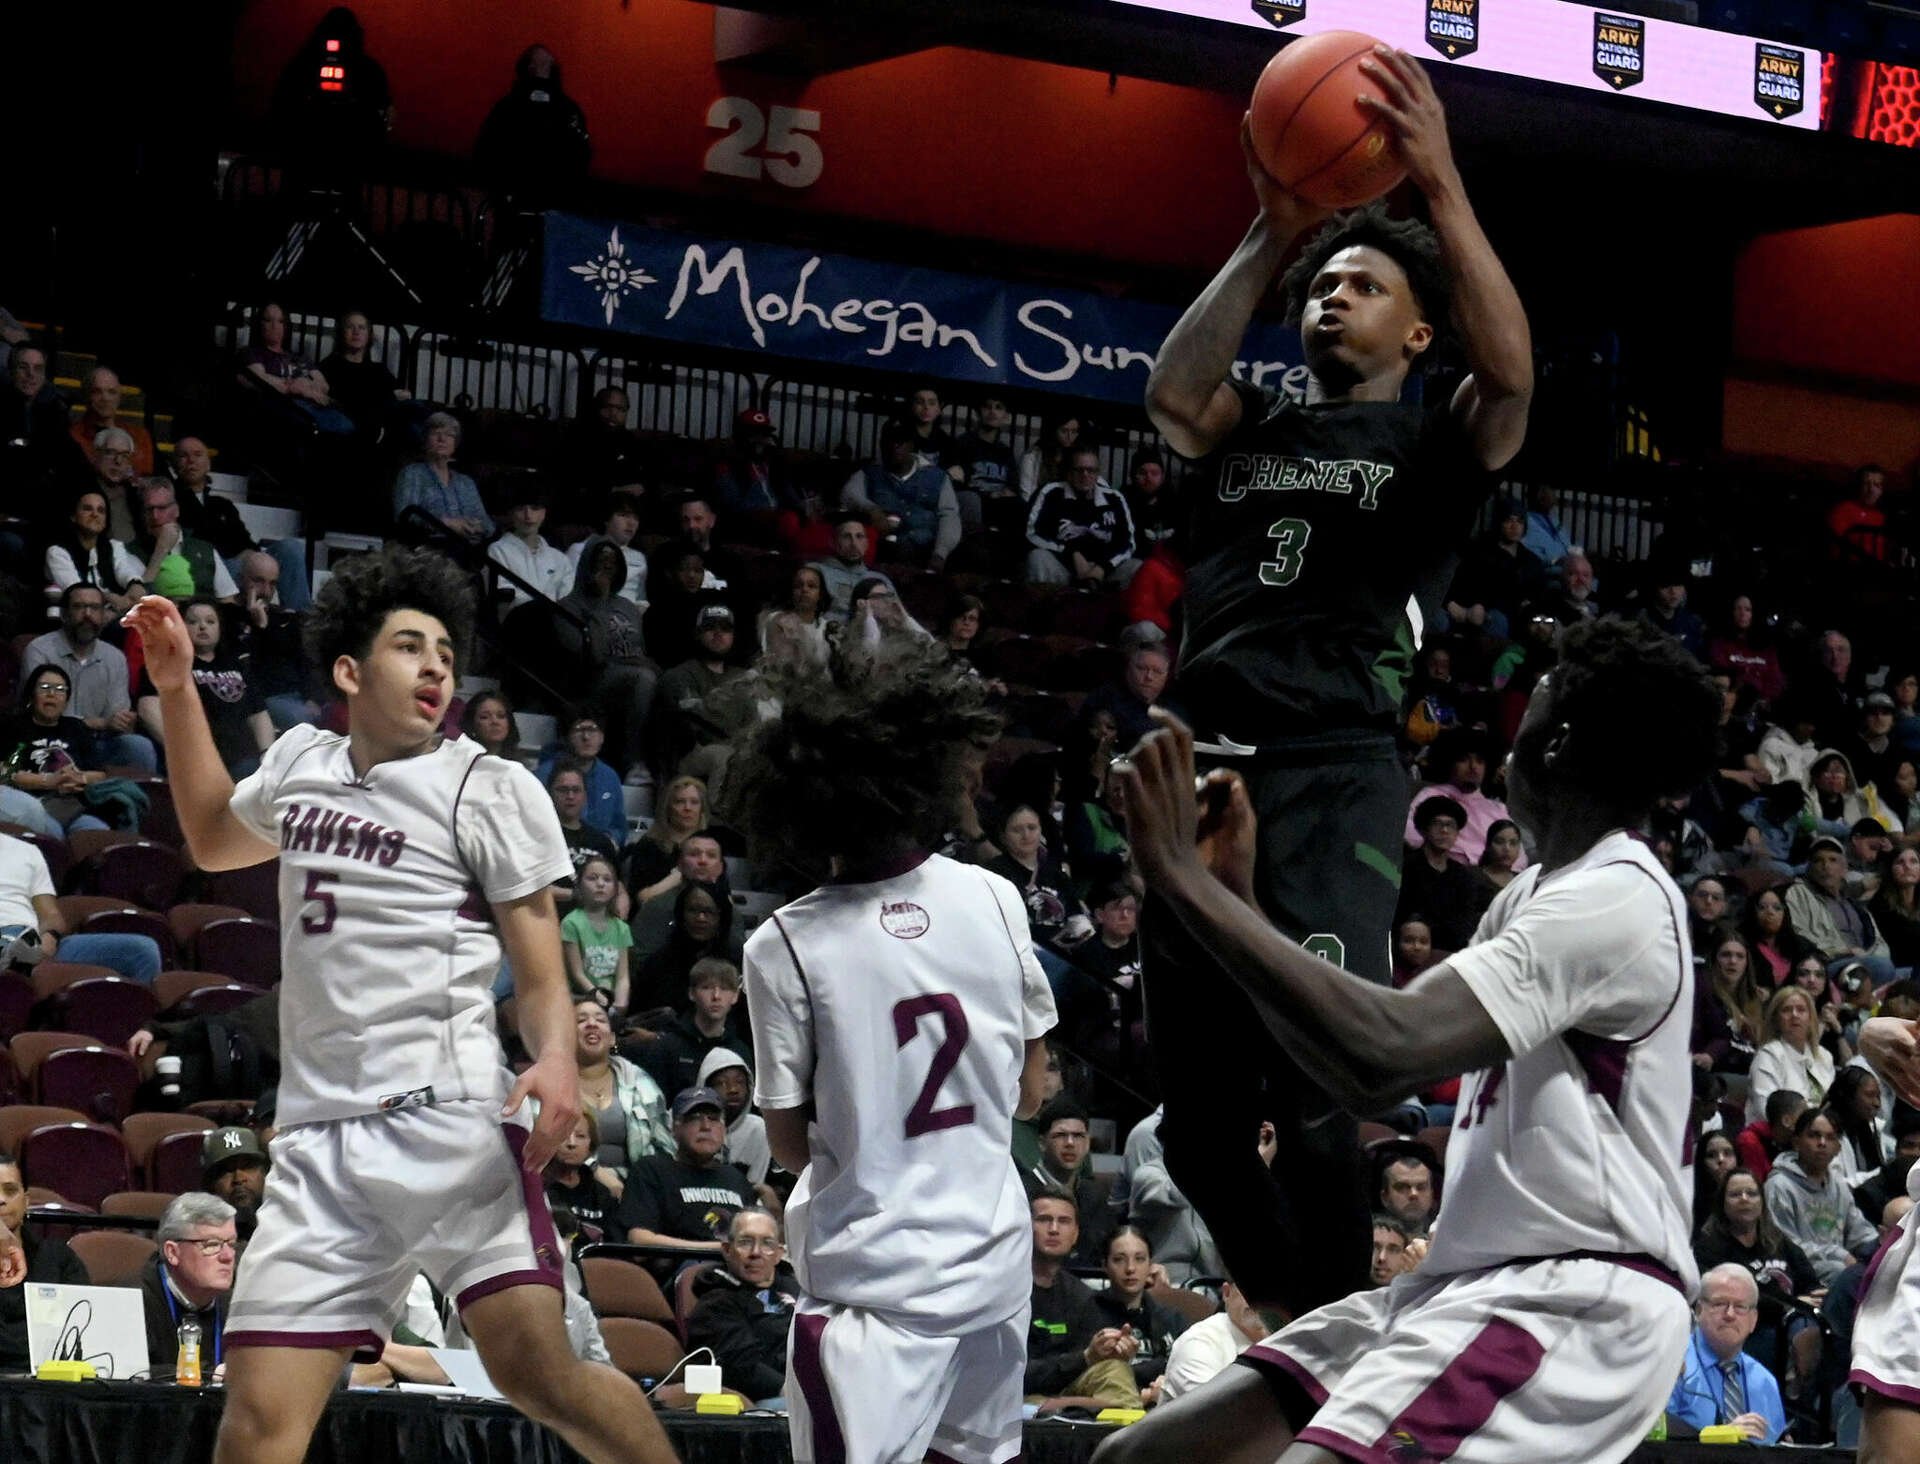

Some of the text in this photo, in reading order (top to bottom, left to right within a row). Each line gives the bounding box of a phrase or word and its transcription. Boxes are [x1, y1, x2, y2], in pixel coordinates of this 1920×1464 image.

[1429, 20, 1475, 40] GUARD
[1431, 0, 1474, 16] ARMY
[1599, 27, 1640, 46] ARMY
[1597, 51, 1641, 71] GUARD
[1760, 58, 1800, 77] ARMY
[1758, 81, 1801, 101] GUARD
[703, 96, 824, 189] 25
[664, 243, 998, 367] Mohegan
[1013, 299, 1157, 382] Sun
[1217, 452, 1395, 511] CHENEY
[1257, 516, 1312, 587] 3
[282, 803, 406, 867] RAVENS
[301, 869, 341, 935] 5
[892, 992, 976, 1140] 2
